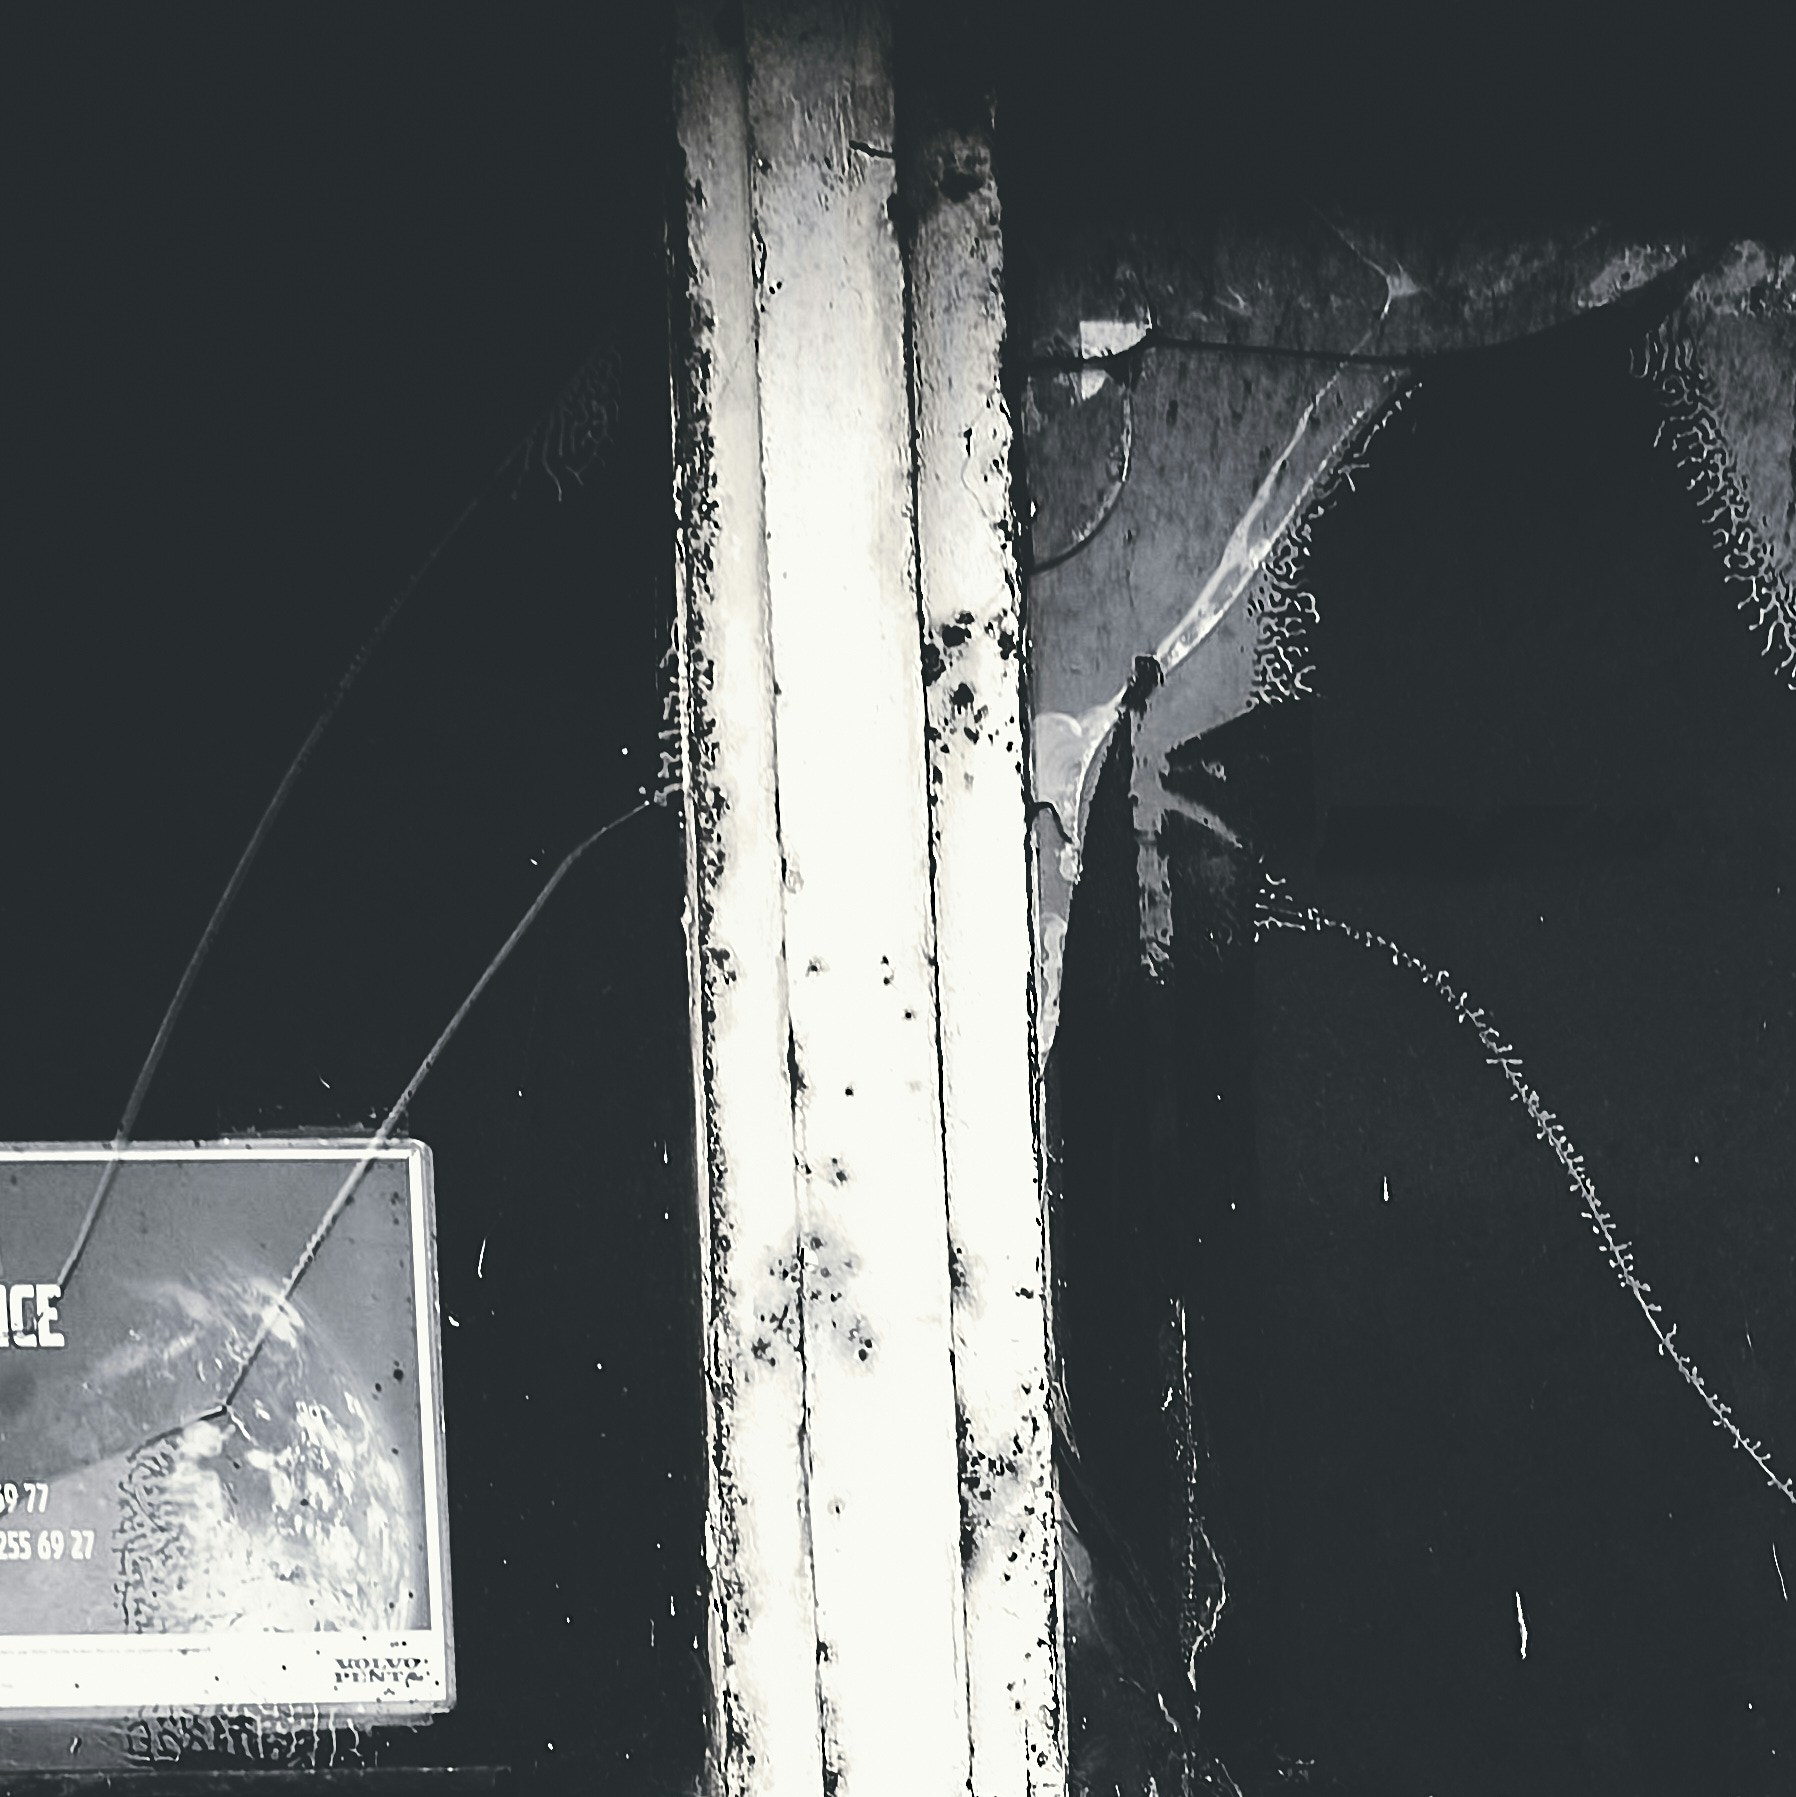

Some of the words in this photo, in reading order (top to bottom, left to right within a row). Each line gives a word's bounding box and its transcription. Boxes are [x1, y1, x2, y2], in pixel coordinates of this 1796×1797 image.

[23, 1482, 49, 1513] 77
[37, 1530, 64, 1560] 69
[70, 1529, 95, 1560] 27
[335, 1658, 421, 1669] VOLVO
